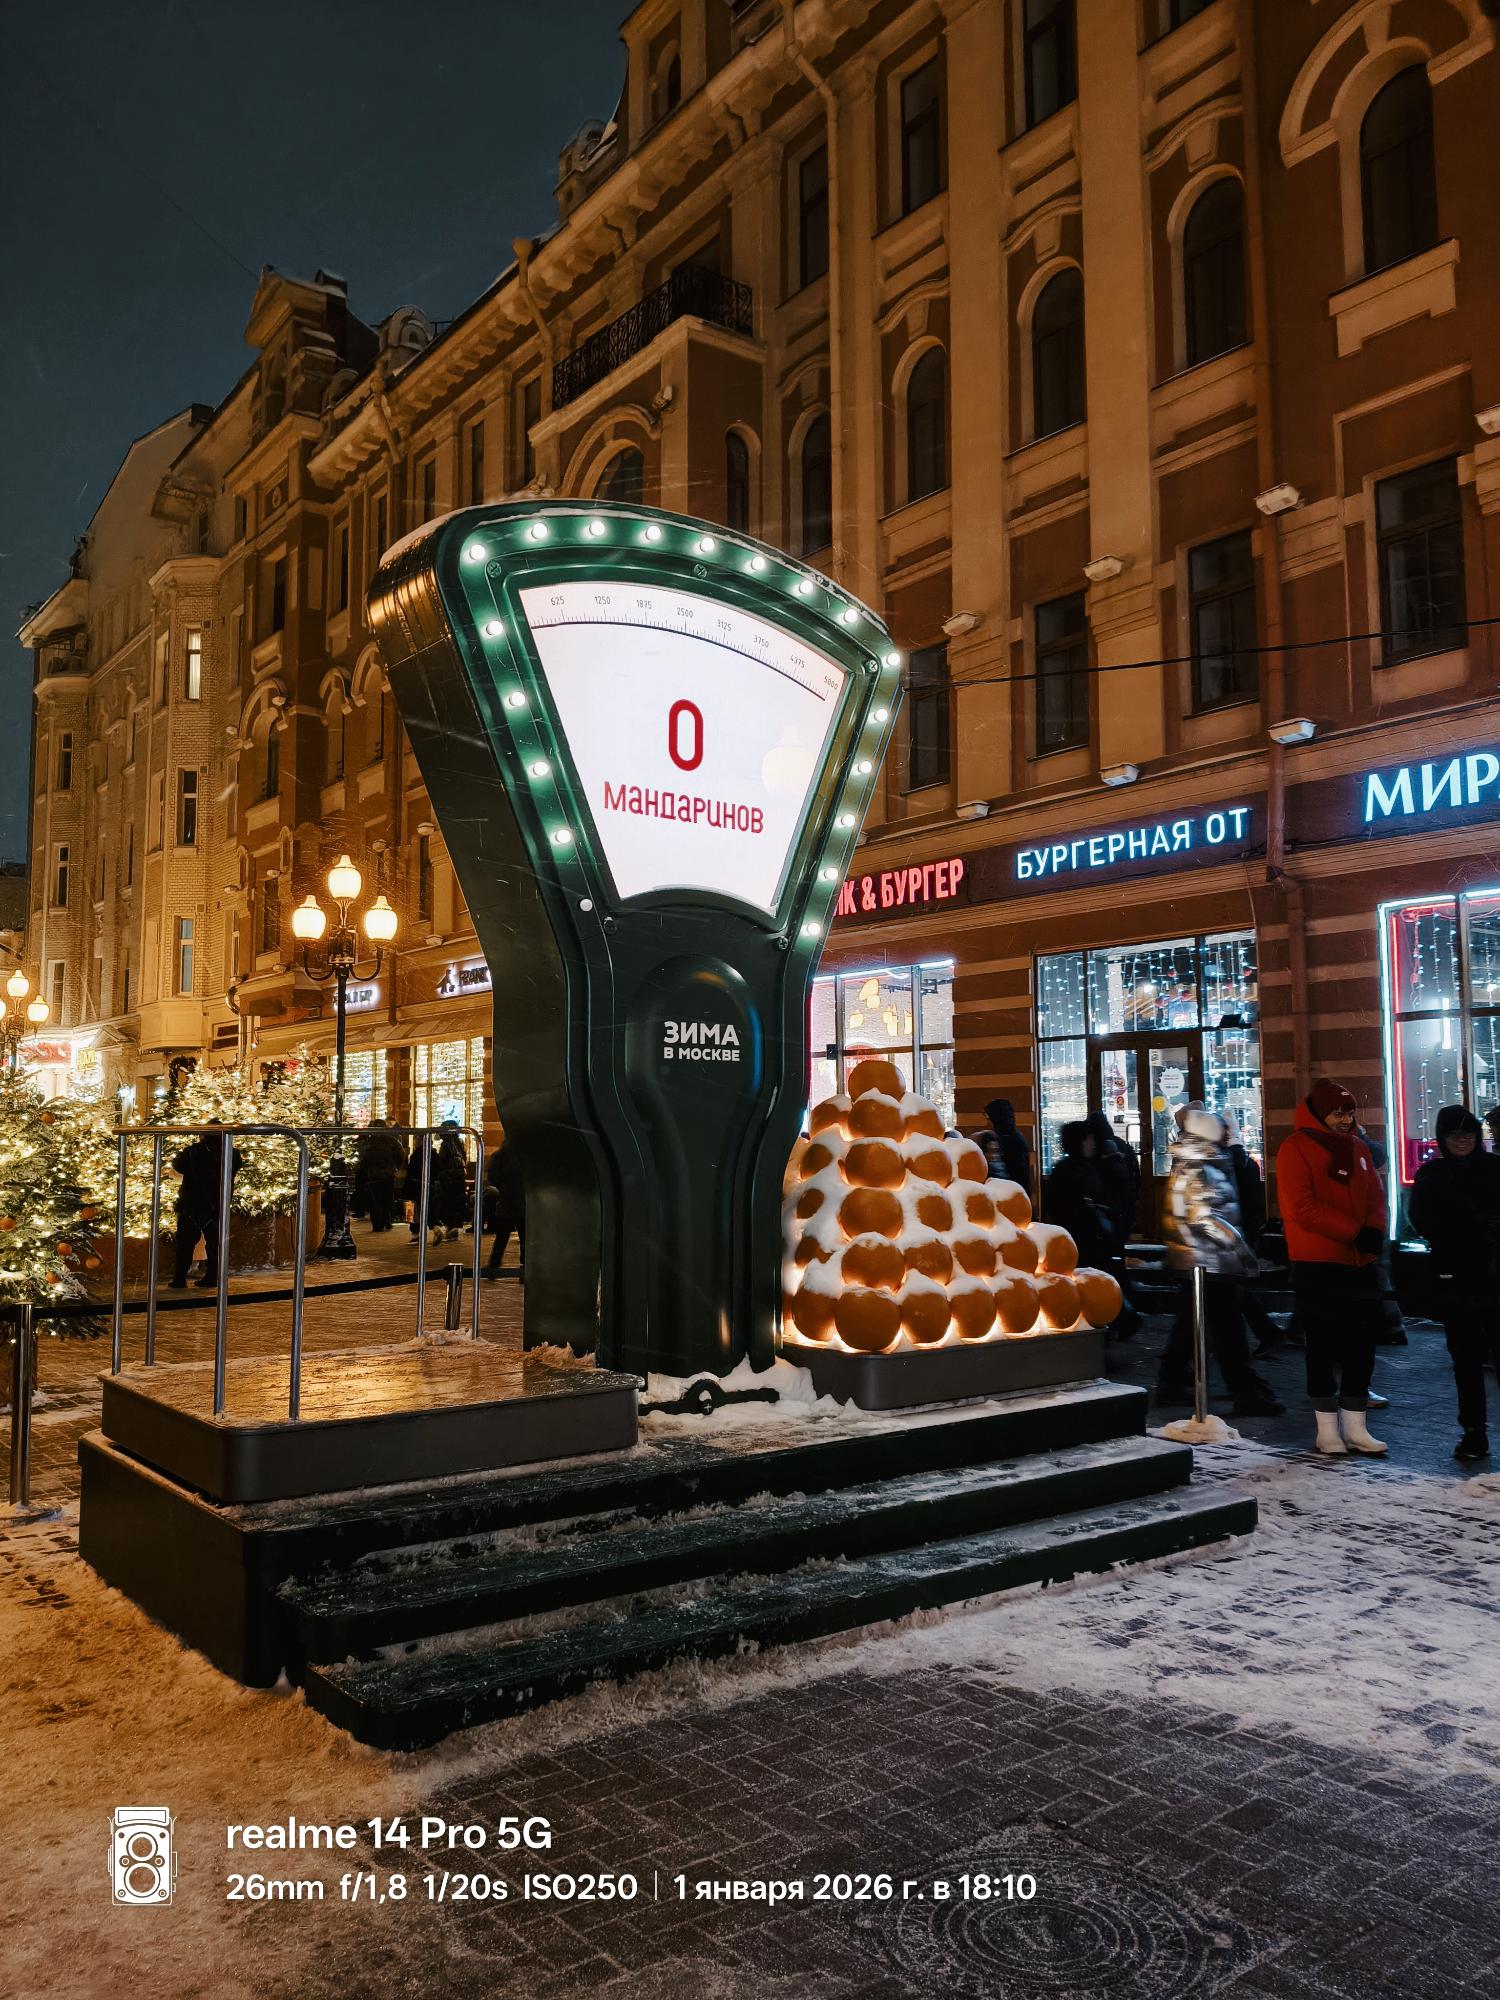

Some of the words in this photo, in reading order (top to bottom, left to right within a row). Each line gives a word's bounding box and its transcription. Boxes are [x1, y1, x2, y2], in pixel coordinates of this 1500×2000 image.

[550, 596, 565, 606] 625
[594, 596, 611, 605] 1250
[636, 599, 653, 610] 1875
[676, 607, 694, 619] 2500
[717, 619, 732, 632] 3125
[753, 635, 770, 648] 3750
[790, 655, 806, 669] 4375
[824, 675, 839, 690] 5000
[668, 699, 704, 772] 0
[604, 781, 764, 834] Мандаринов
[1365, 753, 1500, 822] МИР
[1016, 818, 1192, 880] БУРГЕРНАЯ
[1205, 807, 1248, 845] ОТ
[861, 876, 877, 911] &
[881, 858, 965, 908] БУРГЕР
[663, 1021, 740, 1046] ЗИМА
[663, 1046, 674, 1059] В
[678, 1048, 740, 1062] МОСКВЕ
